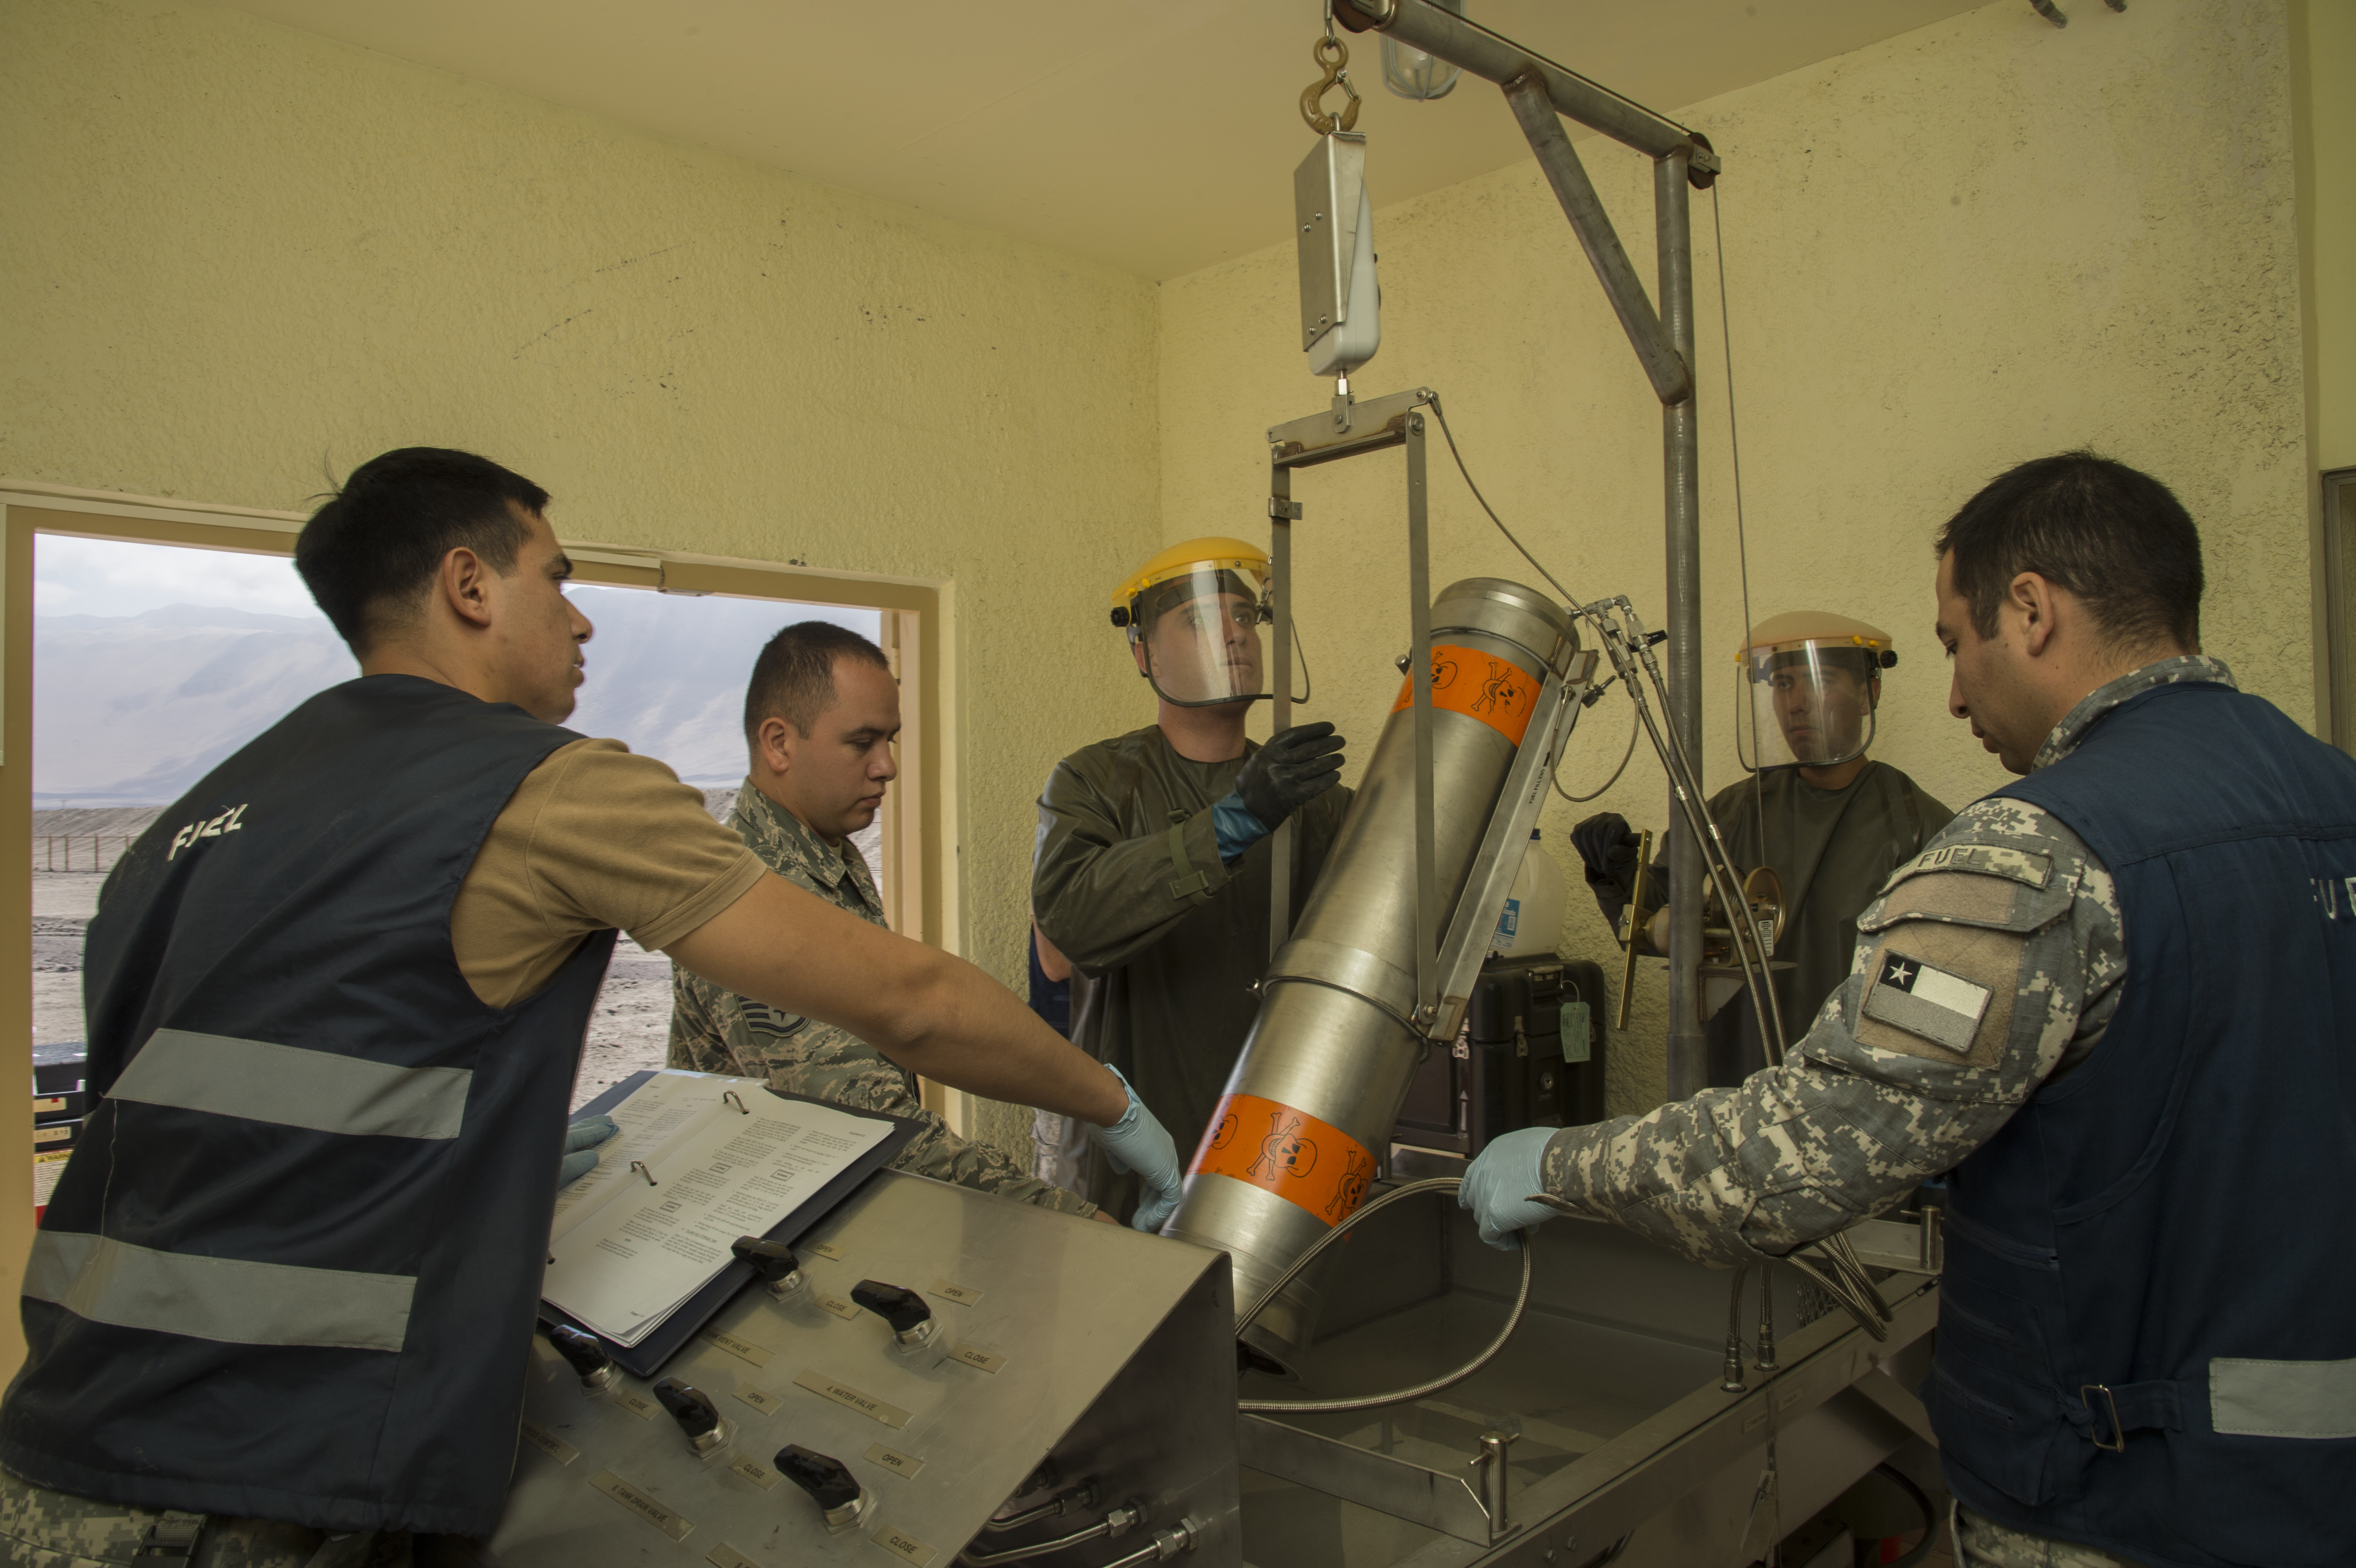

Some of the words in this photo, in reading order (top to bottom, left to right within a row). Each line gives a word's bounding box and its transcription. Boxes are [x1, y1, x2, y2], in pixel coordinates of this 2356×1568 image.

[1529, 791, 1537, 804] FUEL
[1533, 780, 1541, 790] FILL
[1917, 848, 1982, 867] FUEL
[817, 1245, 834, 1253] OPEN
[944, 1288, 964, 1297] OPEN
[826, 1300, 848, 1312] CLOSE
[718, 1336, 734, 1345] VENT
[731, 1342, 751, 1354] VALVE
[964, 1351, 990, 1364] CLOSE
[628, 1398, 648, 1411] CLOSE
[748, 1393, 766, 1404] OPEN
[832, 1388, 857, 1402] WATER
[854, 1397, 877, 1411] VALVE
[538, 1436, 560, 1453] CONTROL
[882, 1454, 904, 1467] OPEN
[743, 1464, 766, 1479] CLOSE
[617, 1488, 633, 1501] TANK
[630, 1497, 651, 1511] DRAIN
[647, 1507, 668, 1523] VALVE
[890, 1536, 917, 1554] CLOSE
